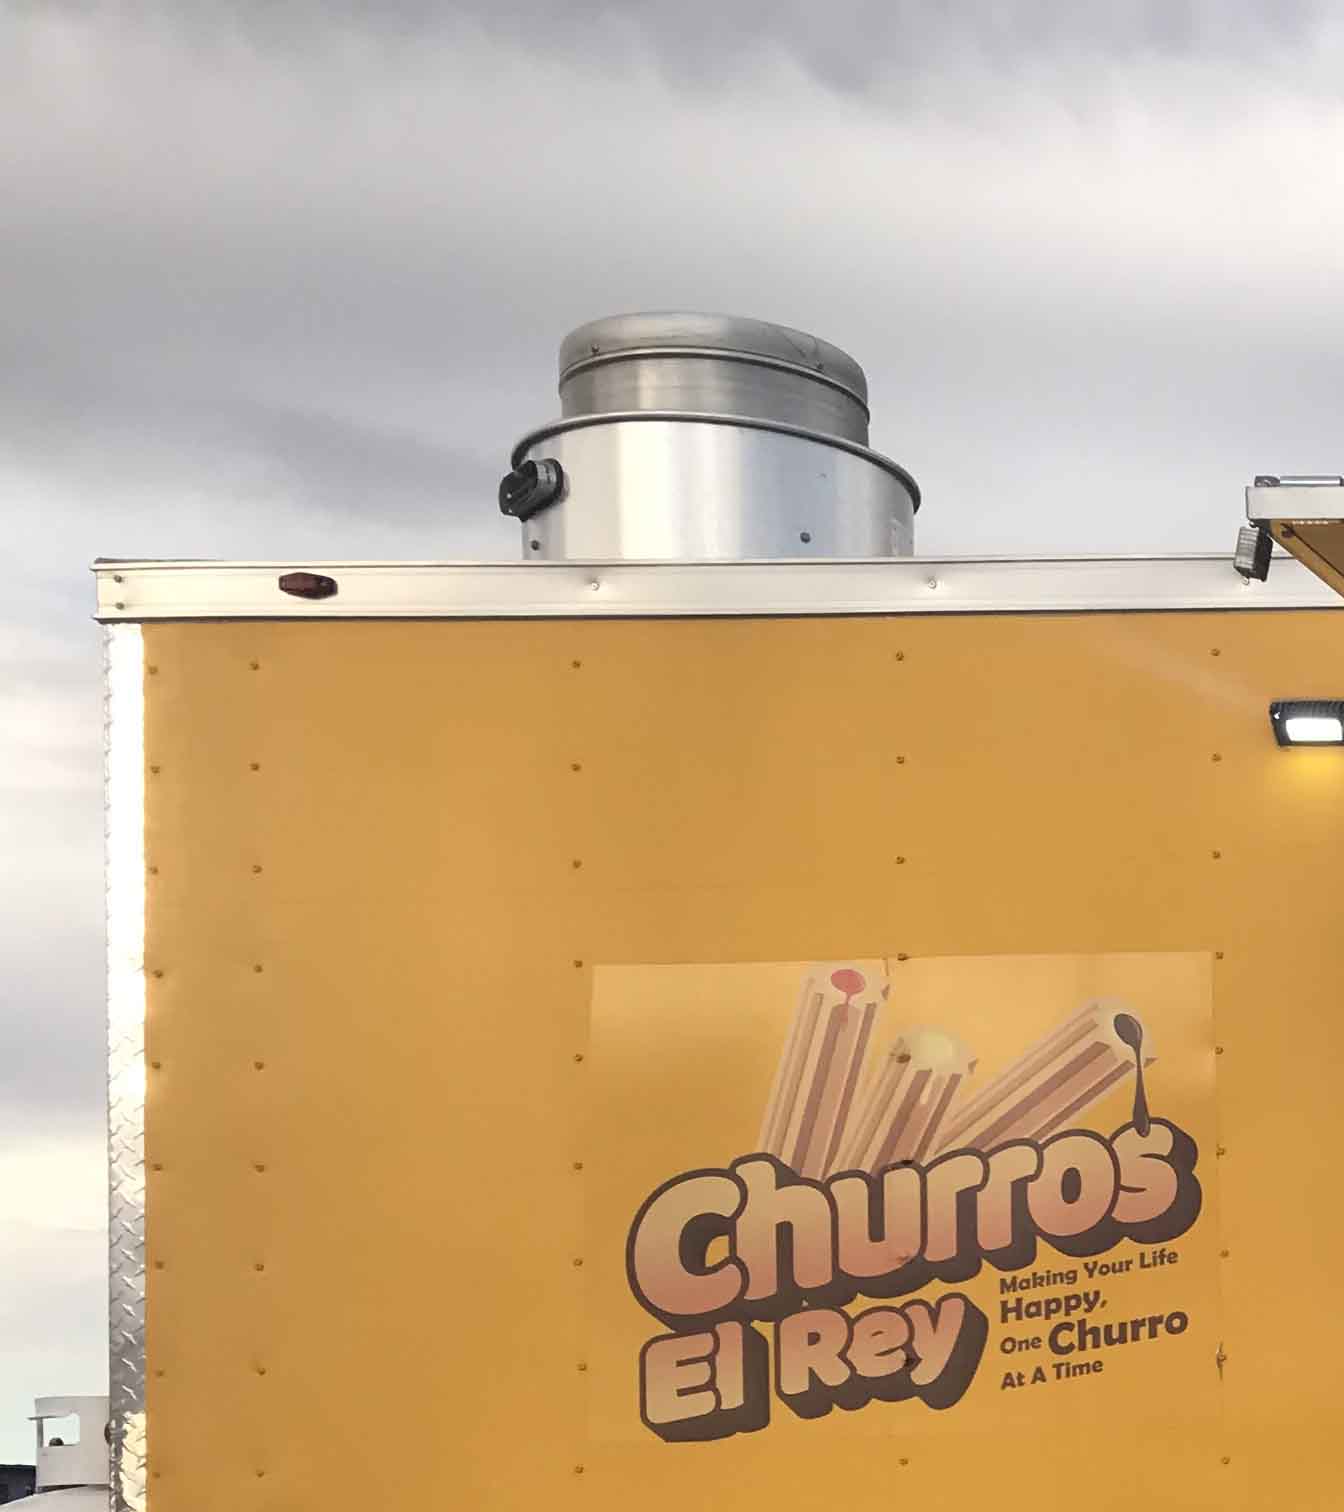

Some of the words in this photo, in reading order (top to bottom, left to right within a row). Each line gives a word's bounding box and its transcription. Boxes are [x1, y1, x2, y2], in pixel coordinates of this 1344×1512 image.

[626, 1117, 1202, 1332] Churros
[1000, 1269, 1077, 1296] Making
[1083, 1255, 1134, 1281] Your
[1139, 1248, 1178, 1269] Life
[1000, 1286, 1107, 1324] Happy,
[1000, 1334, 1042, 1355] One
[1047, 1311, 1189, 1356] Churro
[639, 1316, 771, 1442] El
[775, 1293, 989, 1420] Rey
[1000, 1370, 1025, 1390] At
[1030, 1368, 1047, 1386] A
[1053, 1357, 1104, 1381] Time
